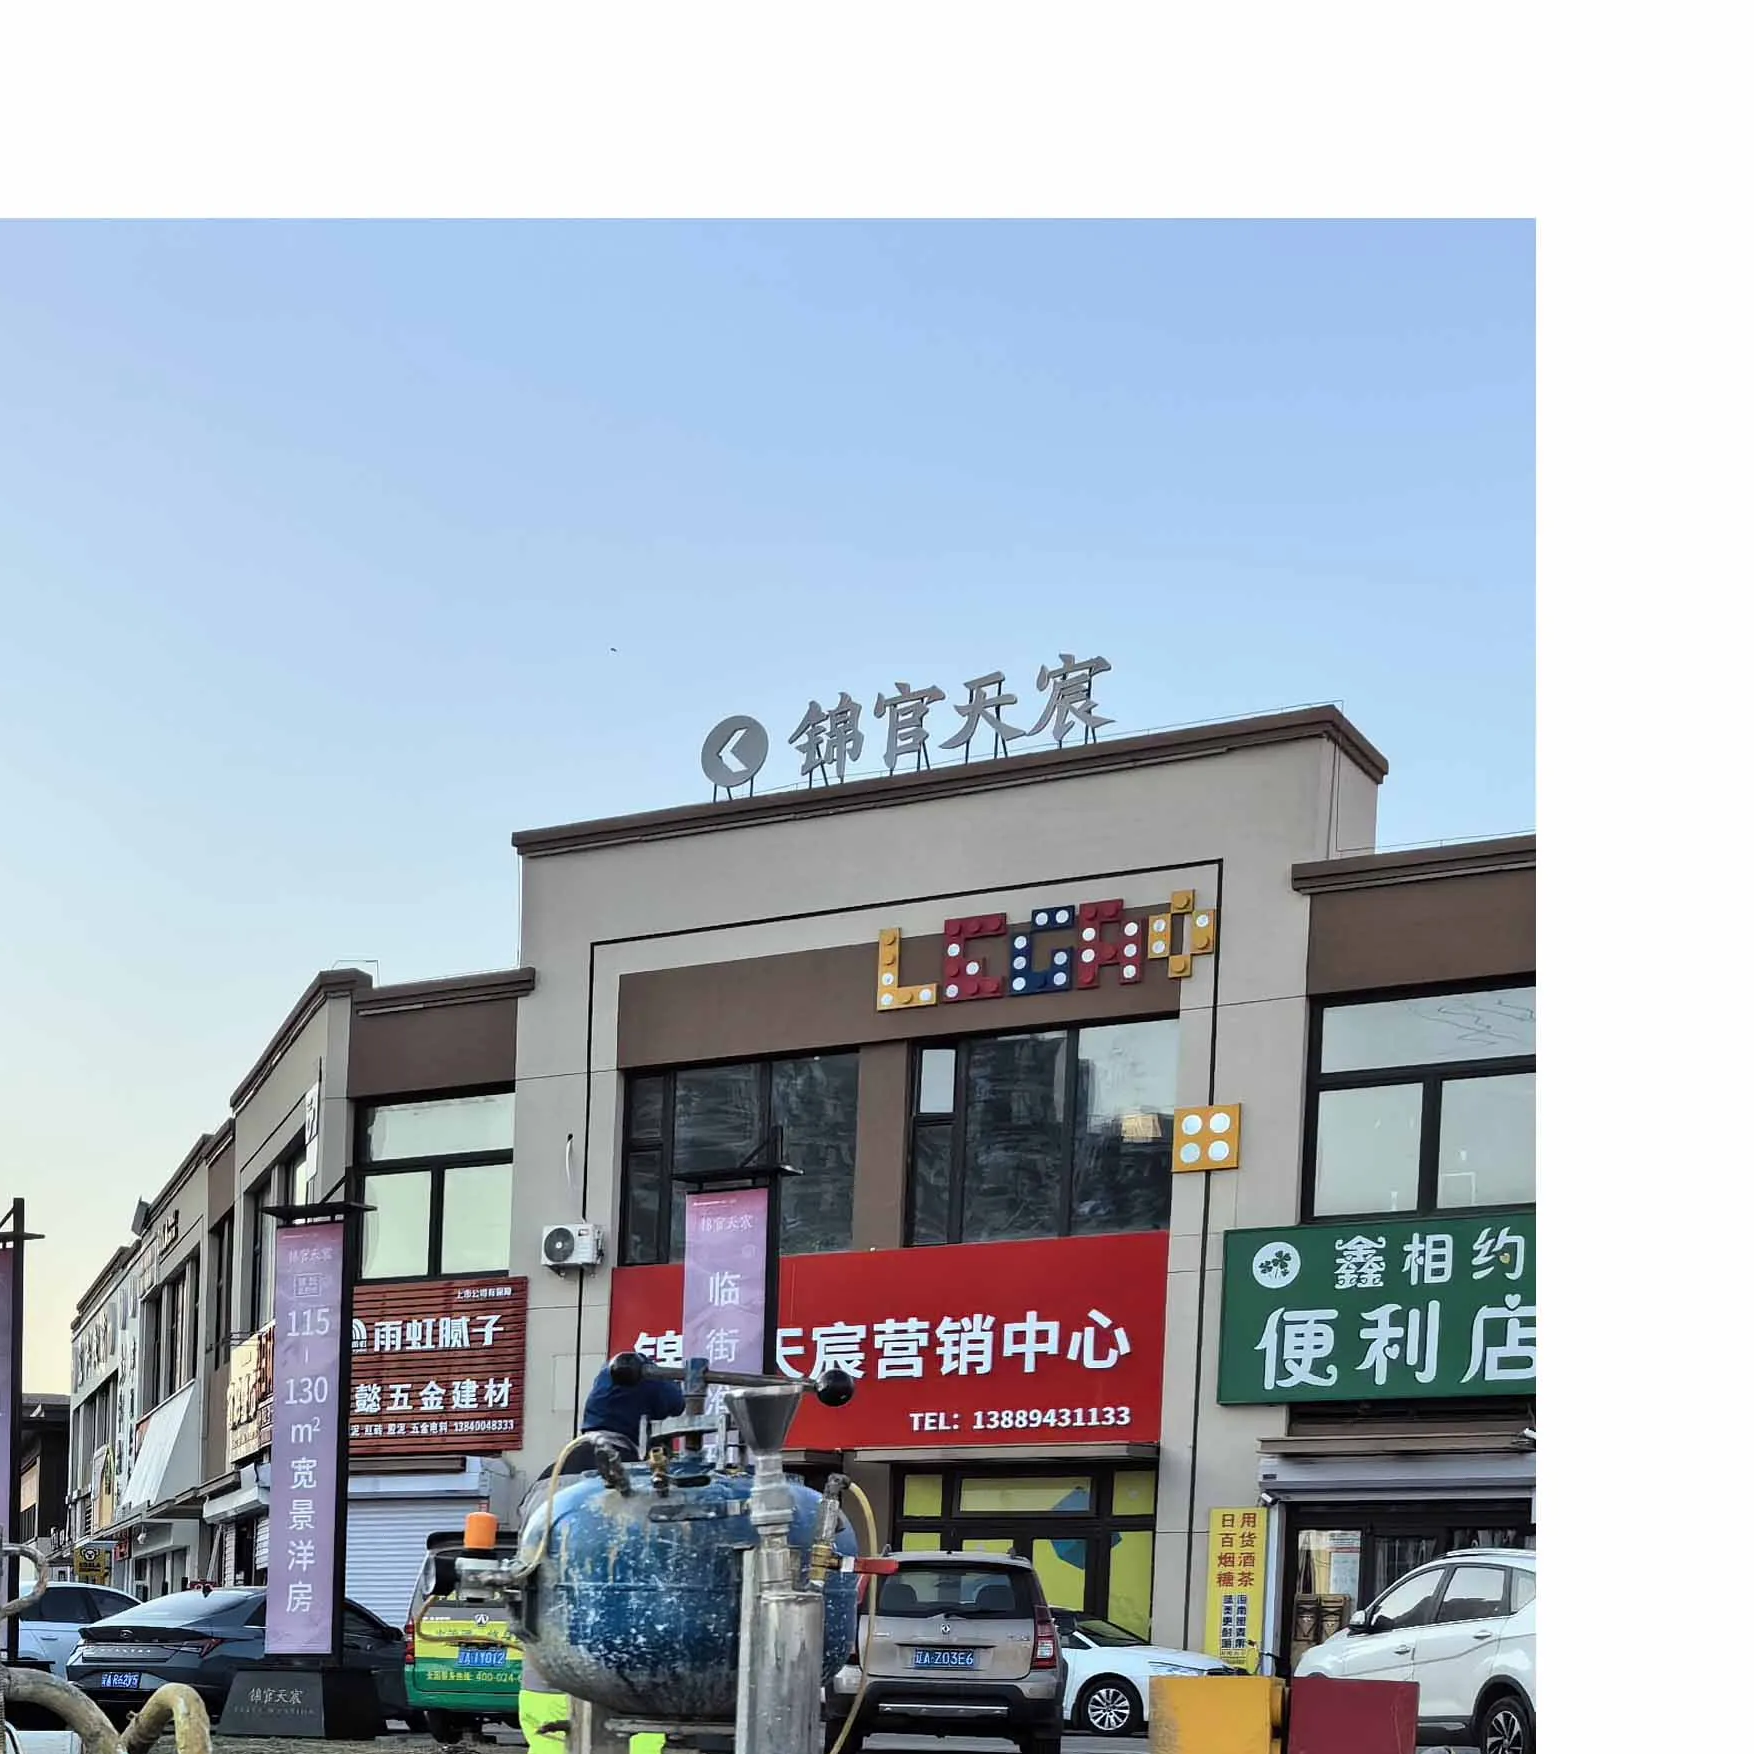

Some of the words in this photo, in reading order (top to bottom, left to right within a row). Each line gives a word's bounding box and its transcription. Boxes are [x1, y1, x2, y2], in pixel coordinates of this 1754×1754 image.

[788, 653, 1116, 778] 锦官天宸
[1334, 1227, 1526, 1289] 鑫相约
[287, 1307, 331, 1338] 115
[373, 1314, 504, 1352] 雨虹腻子
[1253, 1293, 1536, 1391] 便利店
[284, 1375, 329, 1406] 130
[972, 1405, 1132, 1432] 13889431133
[286, 1456, 319, 1613] 宽景洋房
